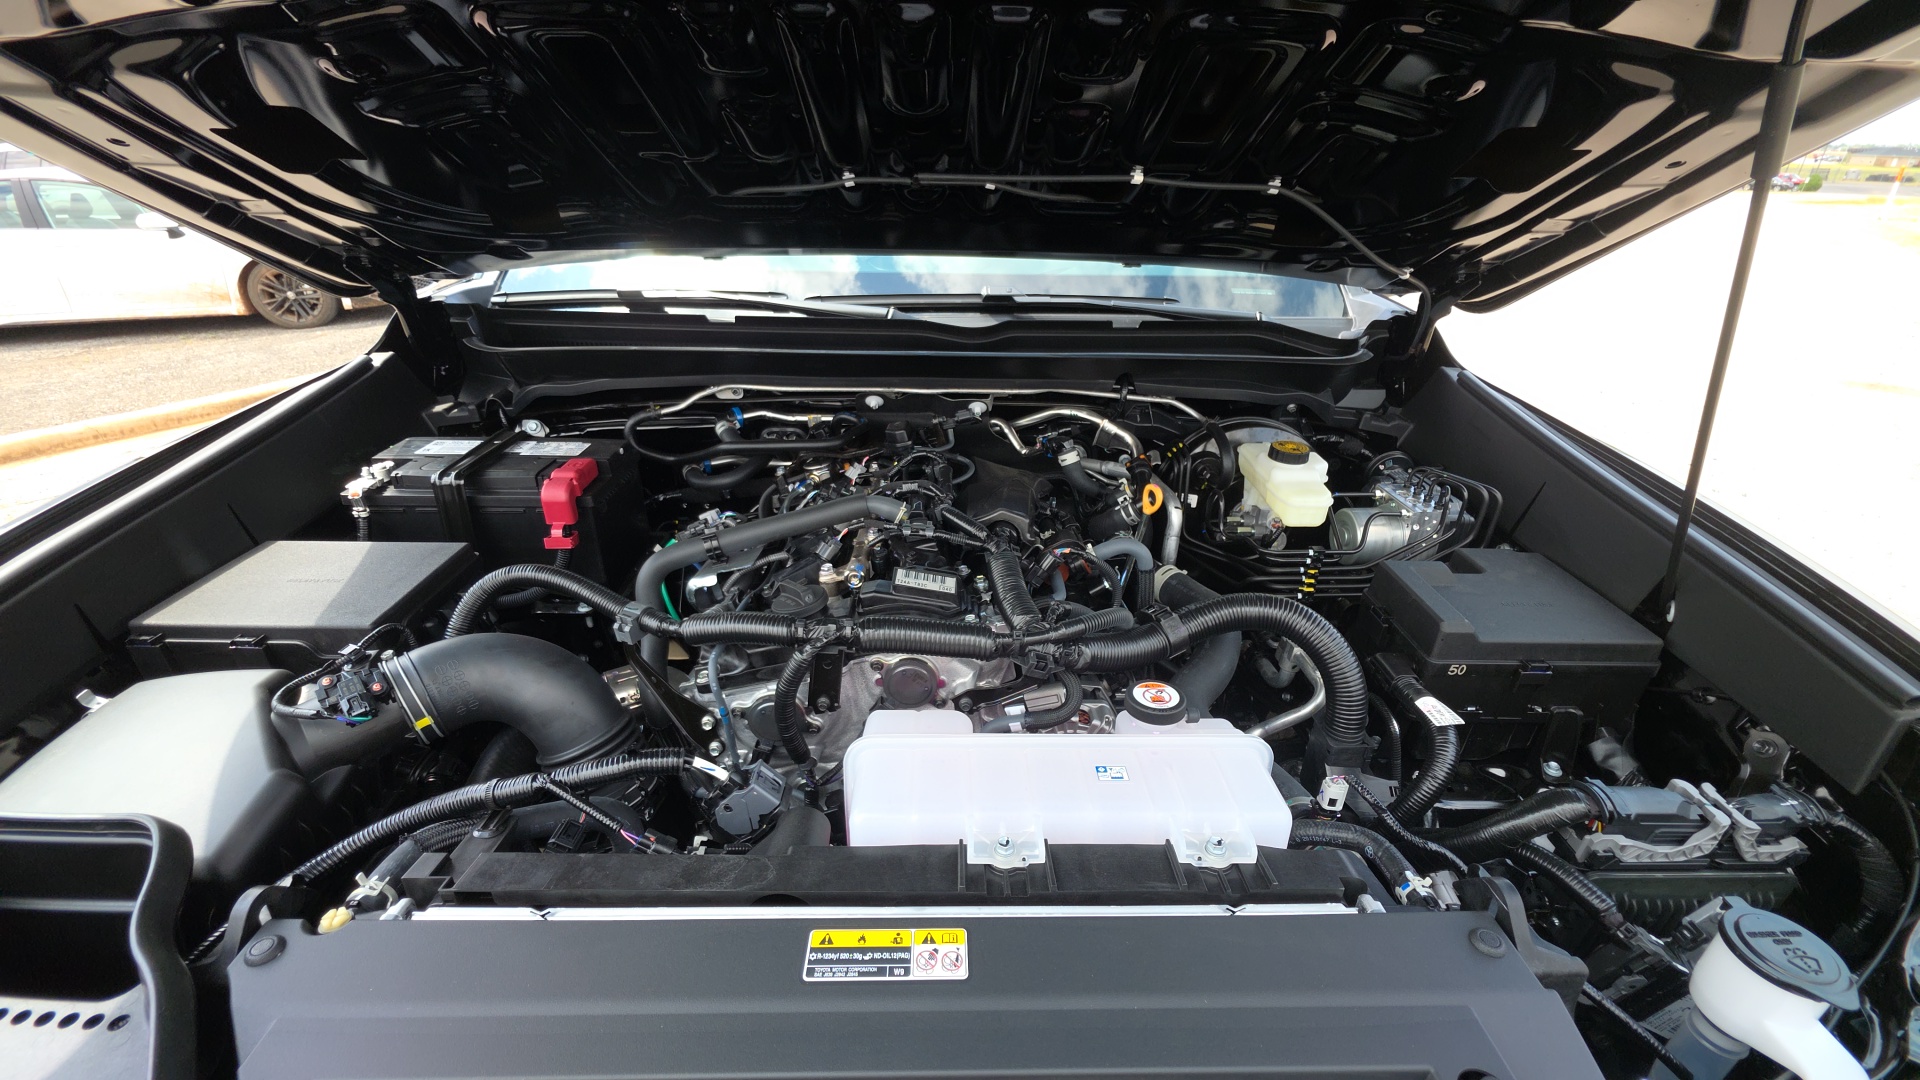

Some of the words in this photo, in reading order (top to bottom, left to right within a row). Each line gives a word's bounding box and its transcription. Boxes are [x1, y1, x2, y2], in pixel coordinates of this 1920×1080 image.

[1447, 664, 1467, 676] 50
[817, 952, 840, 961] R-1234yf
[893, 967, 905, 976] W9
